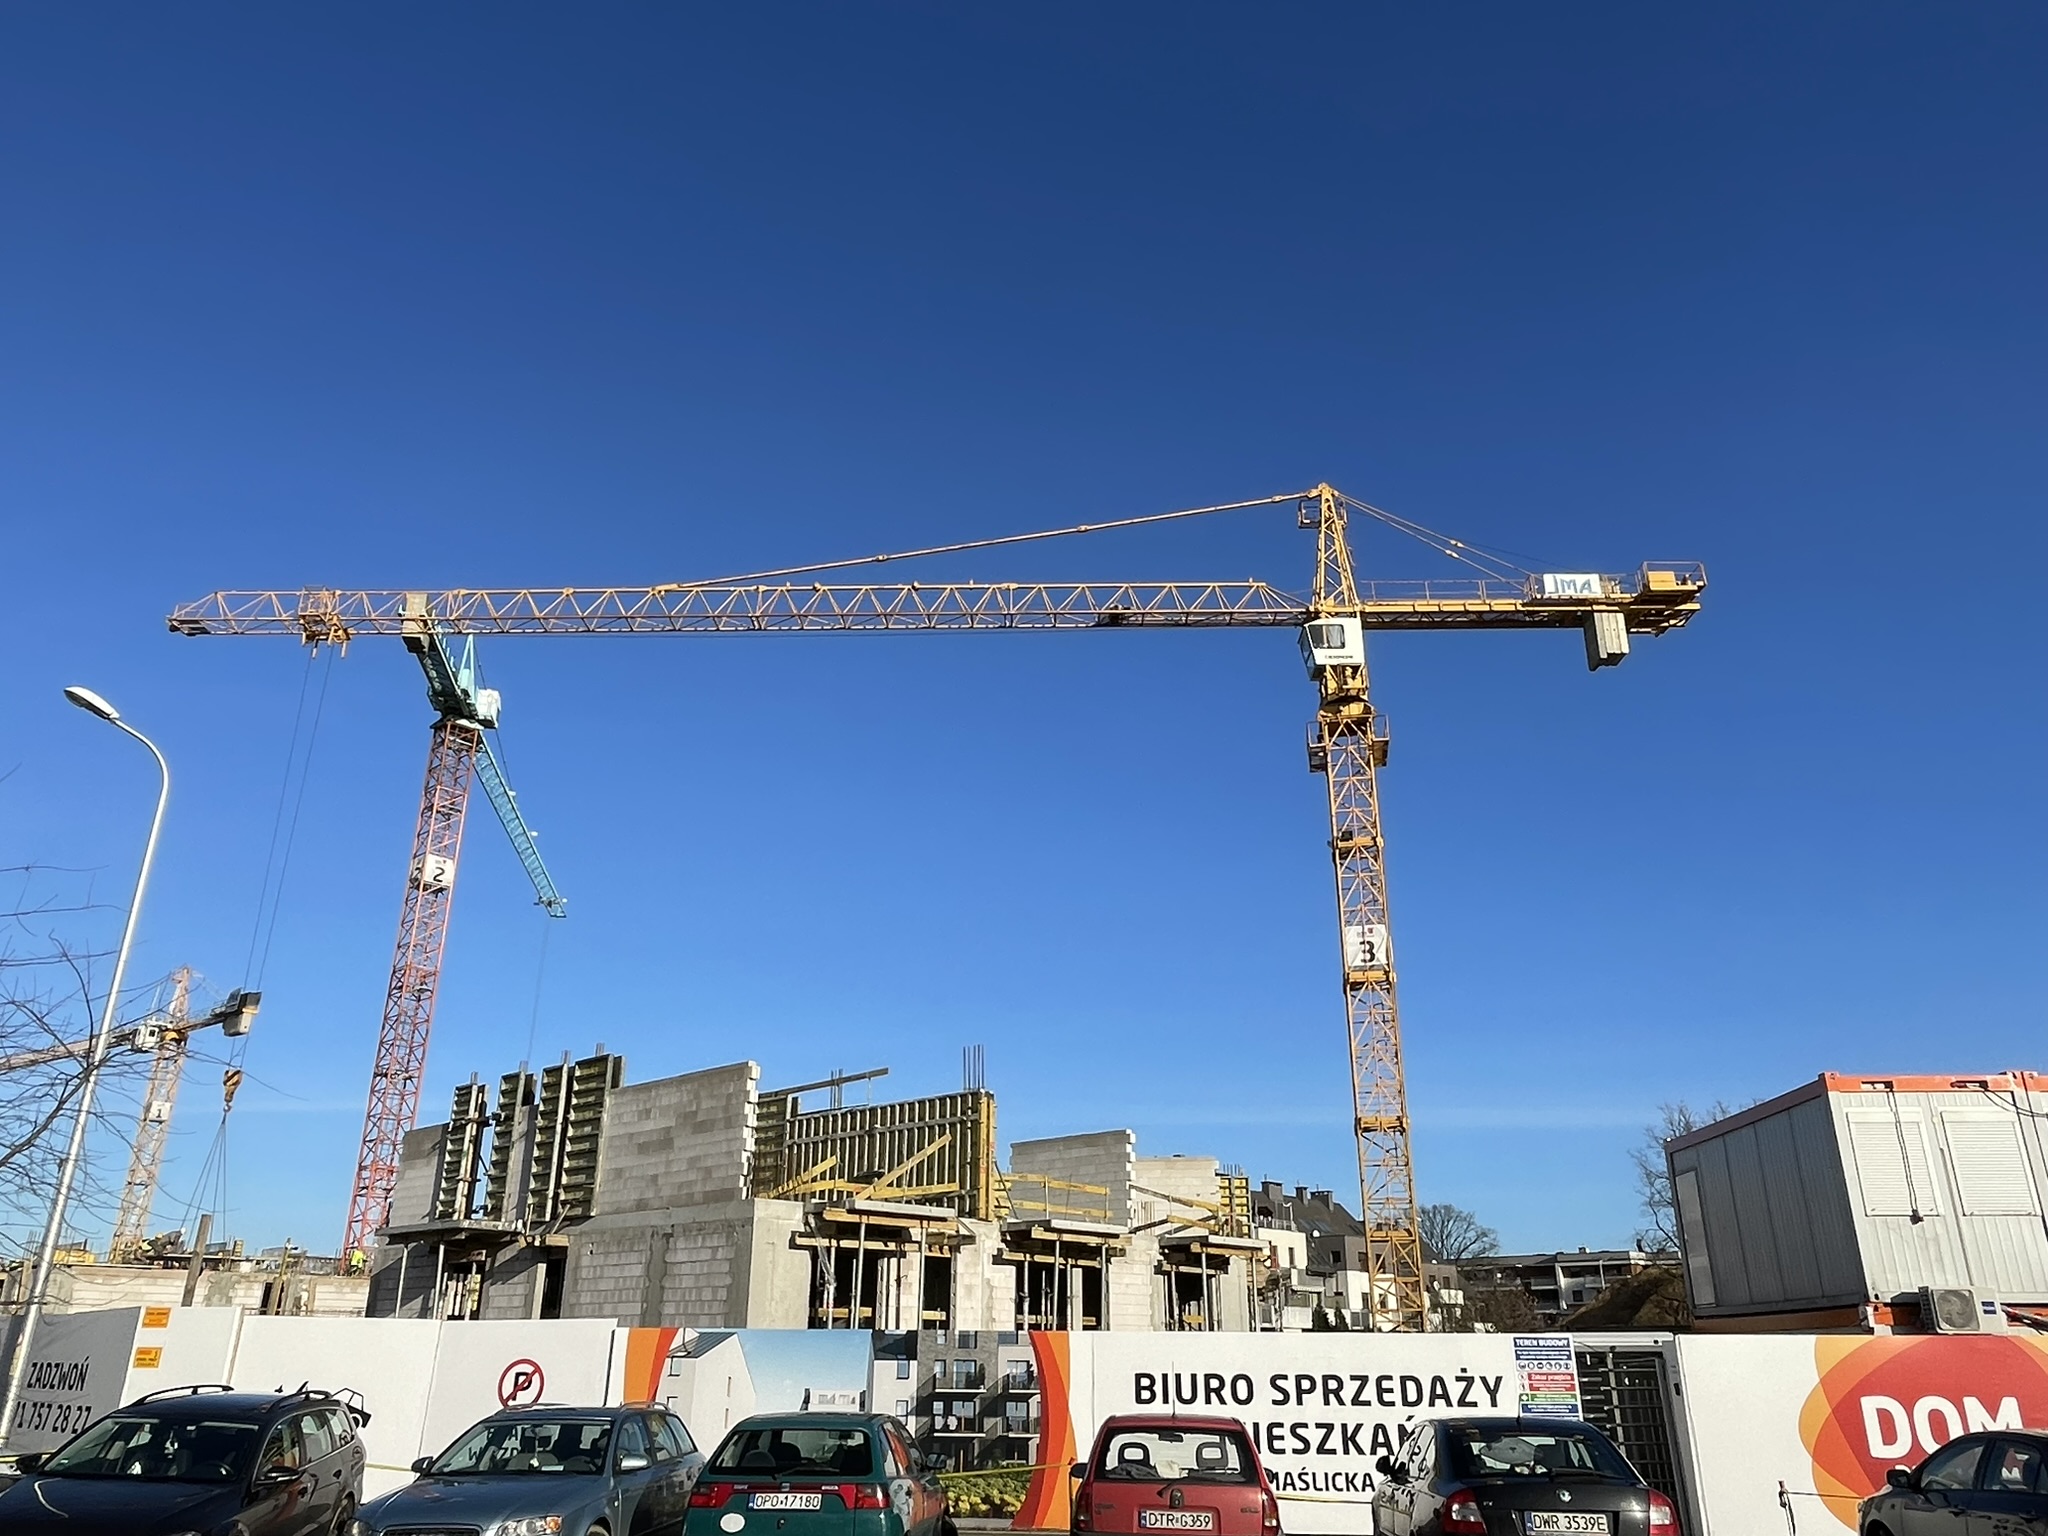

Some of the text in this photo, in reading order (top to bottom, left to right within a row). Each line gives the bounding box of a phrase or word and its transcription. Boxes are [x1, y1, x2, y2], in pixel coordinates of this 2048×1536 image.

[433, 867, 445, 883] 2
[1359, 940, 1376, 964] 3
[156, 1108, 162, 1119] 1
[26, 1355, 90, 1392] ZADZWOŃ
[1134, 1368, 1504, 1408] BIURO SPRZEDAŻY
[27, 1401, 53, 1431] 757
[51, 1403, 72, 1434] 28
[70, 1405, 92, 1435] 27
[1860, 1395, 2024, 1460] DOM
[1243, 1414, 1416, 1456] IESZKA
[755, 1494, 820, 1508] OPO 17180
[1148, 1512, 1211, 1529] DTR G359
[1533, 1514, 1607, 1533] DWR 3539E
